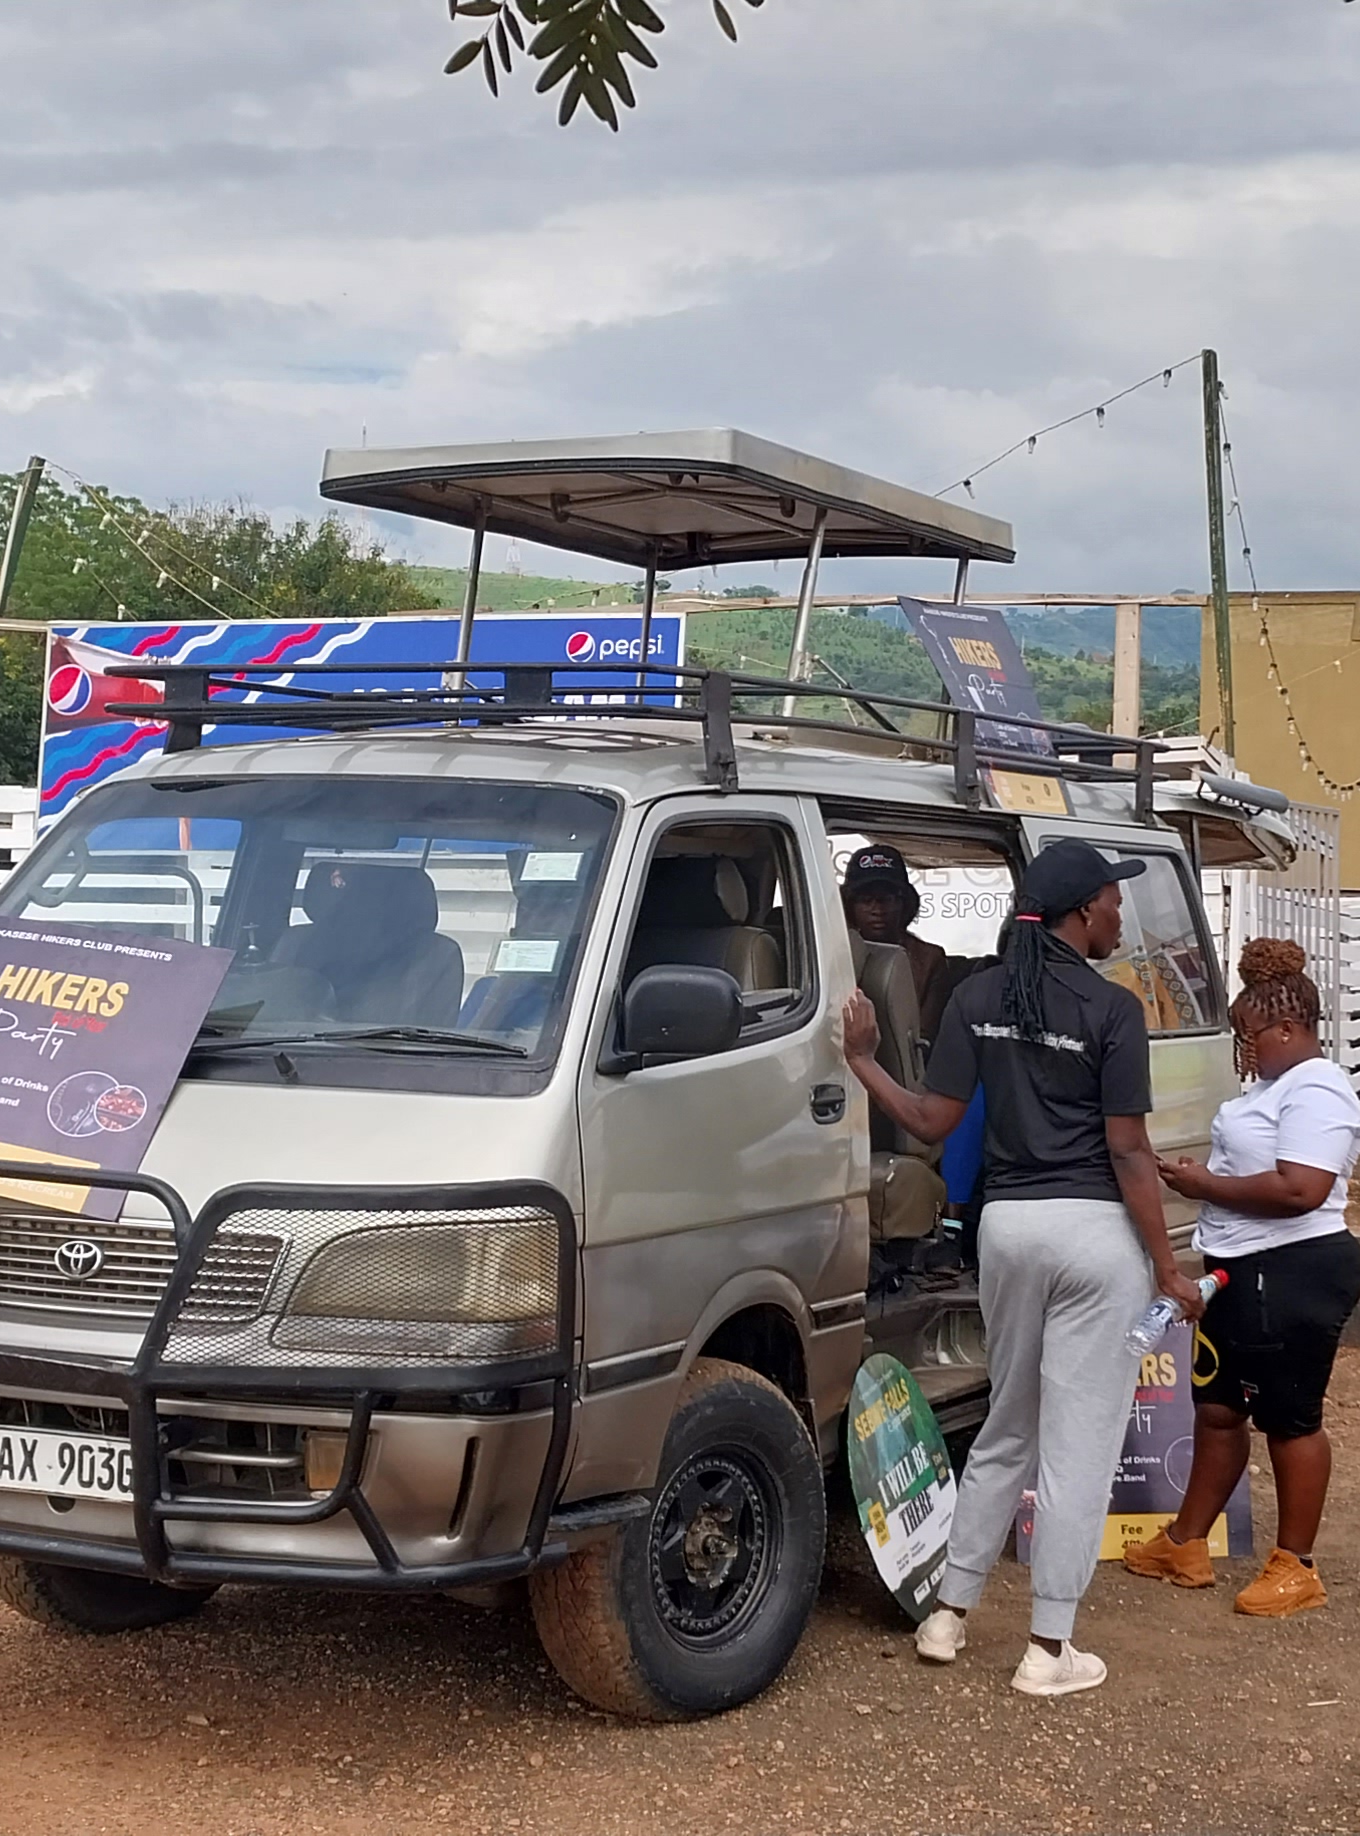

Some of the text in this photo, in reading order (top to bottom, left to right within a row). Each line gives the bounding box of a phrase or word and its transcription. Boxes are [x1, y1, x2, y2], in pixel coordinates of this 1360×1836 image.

[600, 634, 664, 660] pepsi
[948, 636, 1002, 670] HIKERS
[941, 892, 1010, 919] SPOT
[41, 934, 81, 947] HIKERS
[82, 940, 114, 952] CLUB
[114, 944, 173, 962] PRESENTS
[1, 1075, 14, 1085] of
[14, 1076, 49, 1093] Drinks
[1123, 1456, 1161, 1464] of Drinks
[877, 1480, 890, 1508] I
[885, 1456, 916, 1500] WILL
[911, 1440, 930, 1476] BE
[1124, 1473, 1146, 1482] Band
[898, 1487, 934, 1538] THERE
[1121, 1524, 1143, 1535] Fee
